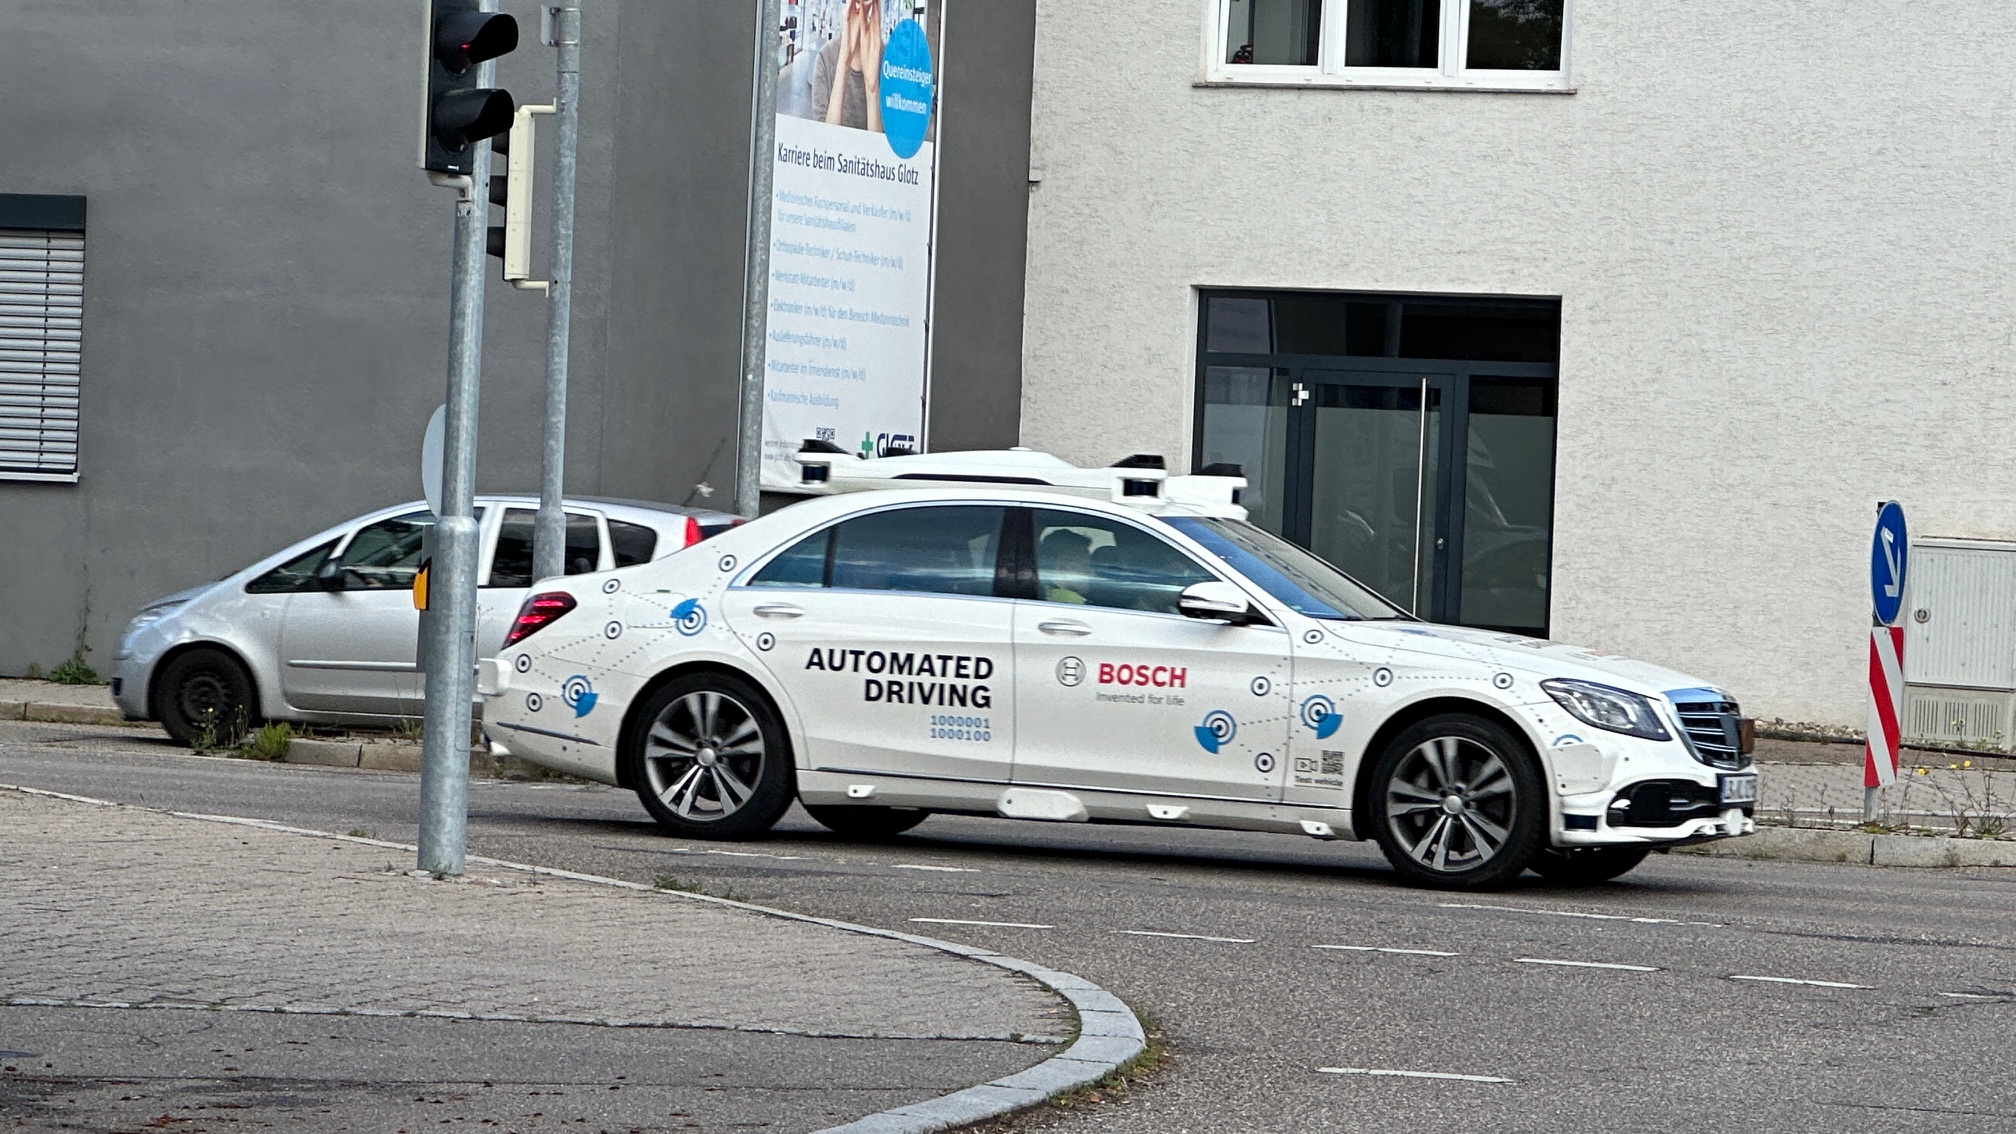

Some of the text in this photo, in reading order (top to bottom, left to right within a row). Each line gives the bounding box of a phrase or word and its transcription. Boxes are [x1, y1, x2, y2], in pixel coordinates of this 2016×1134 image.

[883, 61, 932, 87] Quereinsteiger
[885, 92, 927, 115] willkommen
[778, 142, 919, 185] Karriere beim Sanitätshaus Glotz
[805, 647, 994, 680] AUTOMATED
[1099, 662, 1186, 688] BOSCH
[864, 679, 991, 708] DRIVING
[1096, 692, 1185, 706] Invented for life
[930, 715, 990, 729] 1000001
[930, 728, 991, 741] 1000100
